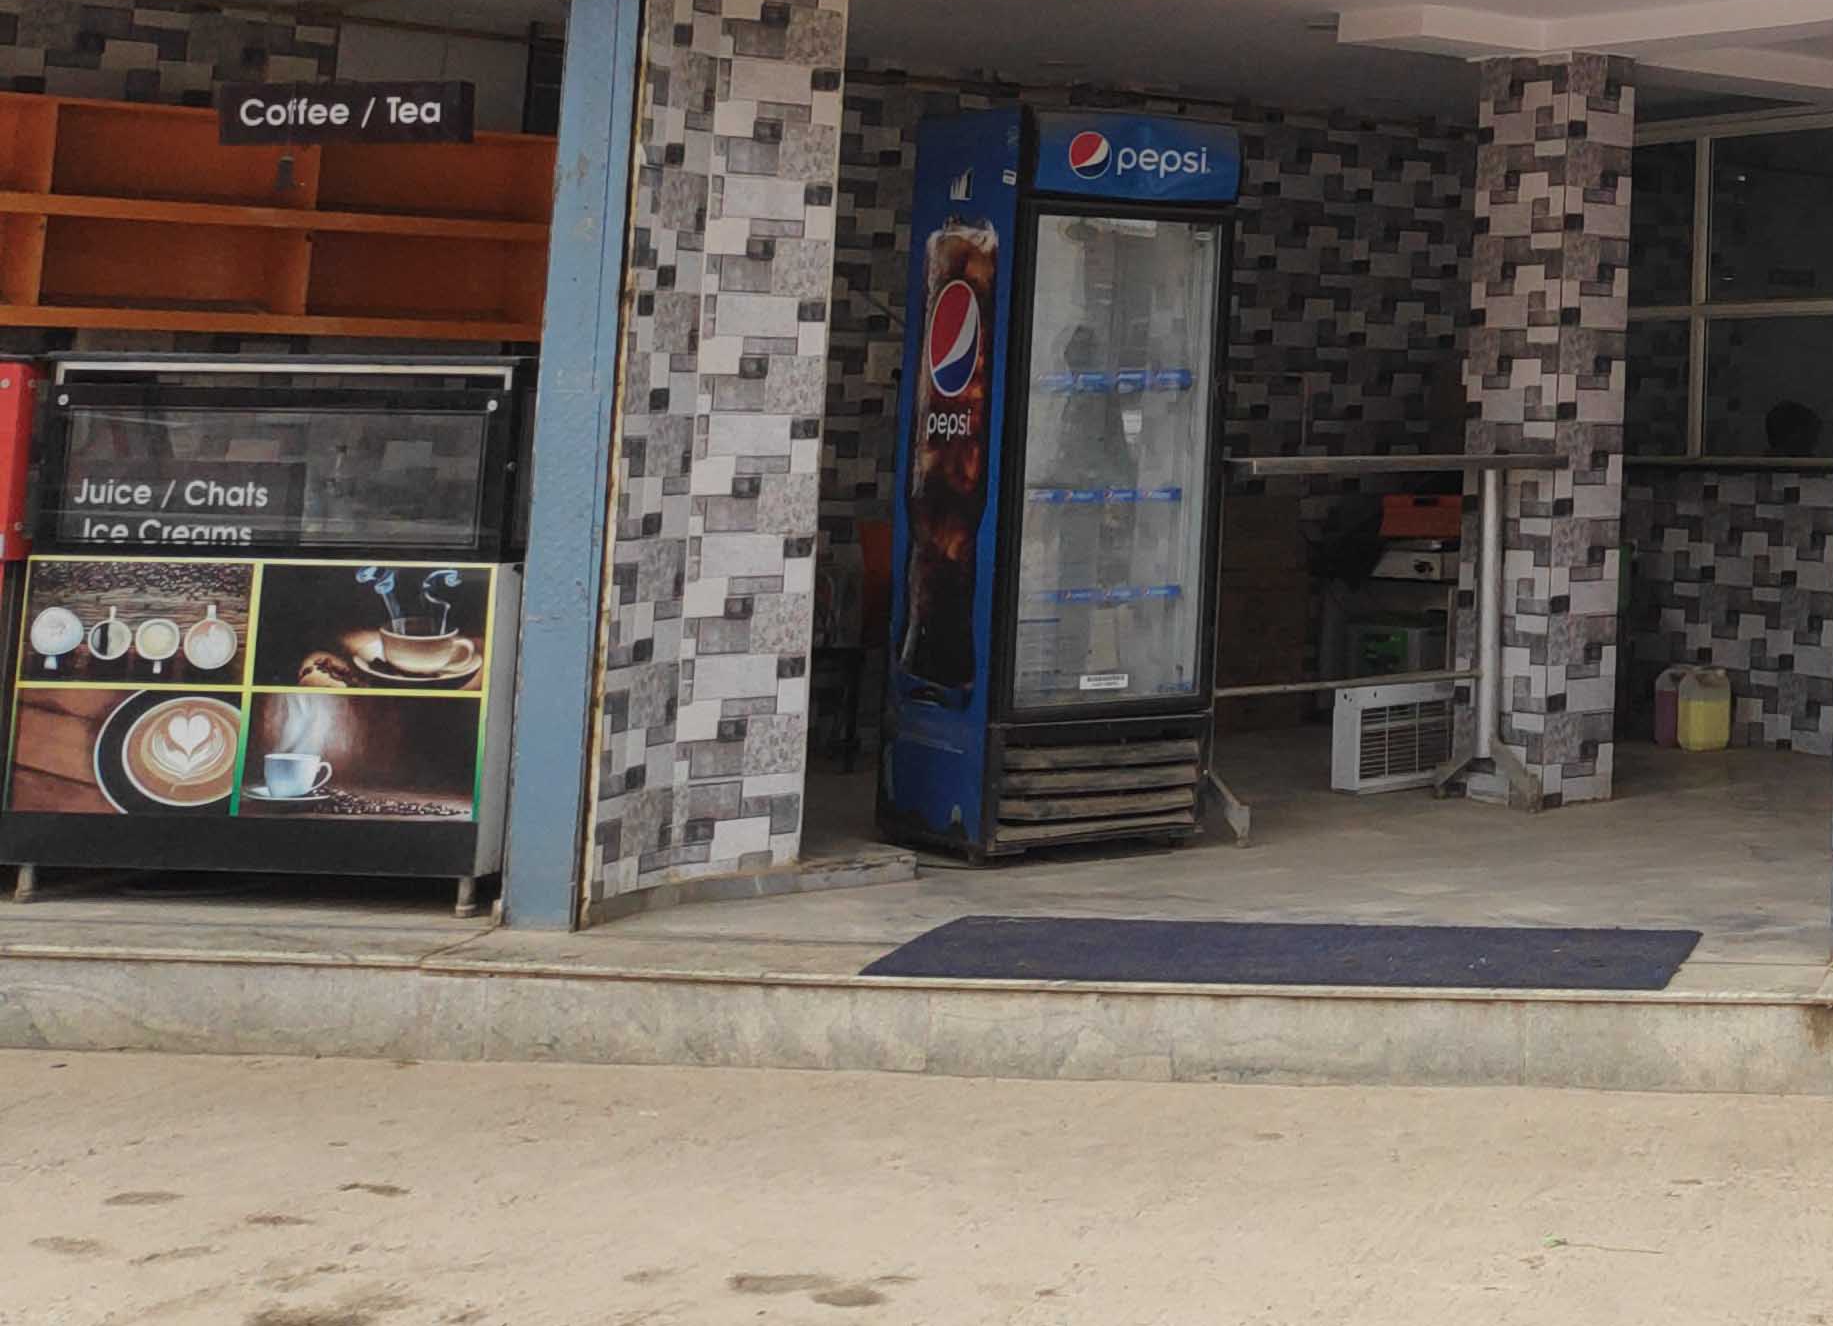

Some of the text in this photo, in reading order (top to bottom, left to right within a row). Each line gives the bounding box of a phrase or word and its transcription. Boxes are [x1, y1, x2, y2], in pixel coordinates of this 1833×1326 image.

[239, 97, 350, 127] Coffee
[386, 96, 441, 124] Tea
[1116, 146, 1208, 179] pepsi
[926, 407, 972, 442] pepsi
[73, 478, 153, 505] Juice
[184, 480, 269, 507] Chats
[82, 518, 254, 546] Ice Creams
